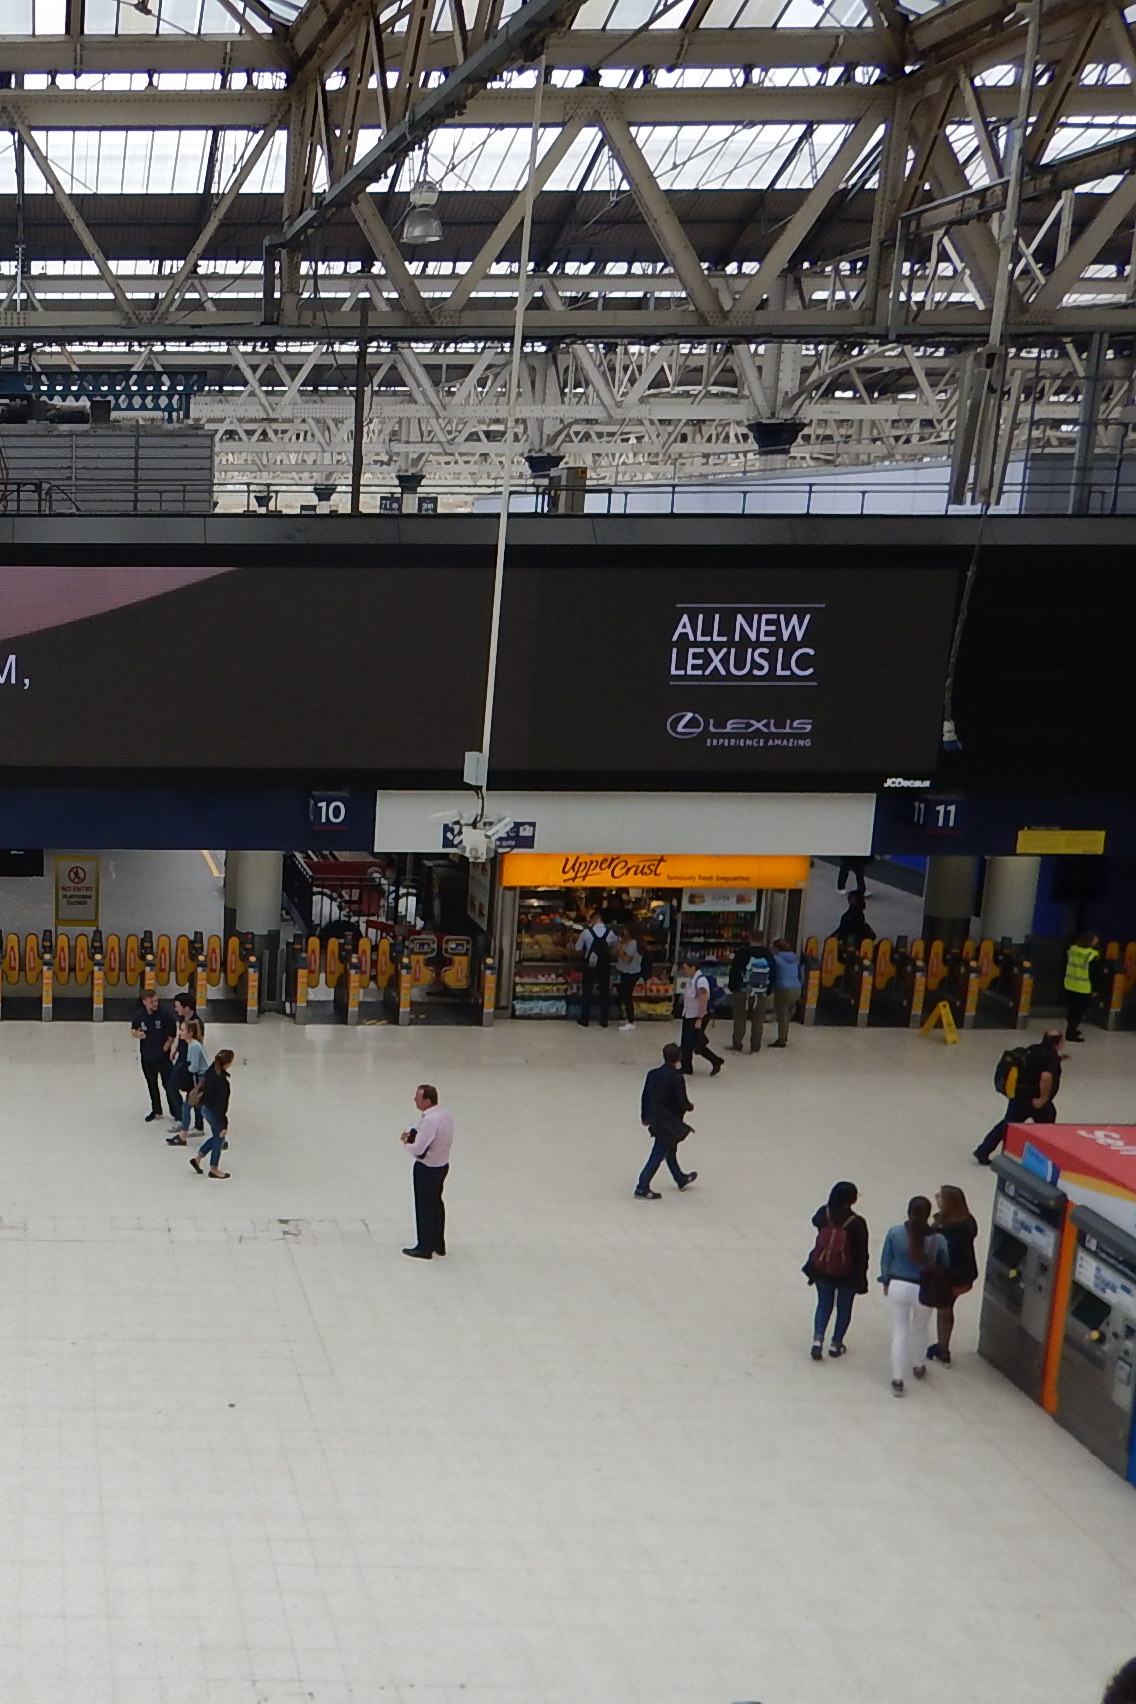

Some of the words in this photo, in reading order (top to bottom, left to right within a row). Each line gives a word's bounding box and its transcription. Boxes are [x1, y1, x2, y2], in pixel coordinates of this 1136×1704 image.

[671, 613, 728, 642] ALL
[734, 613, 811, 642] NEW
[670, 647, 770, 676] LEXUS
[775, 647, 815, 676] LC
[708, 718, 813, 733] LEXUS
[706, 738, 764, 747] EXPERIENCE
[767, 738, 812, 747] AMAZING
[317, 801, 346, 823] 10
[935, 804, 956, 827] 11
[561, 855, 621, 883] Upper
[611, 855, 666, 879] Crust
